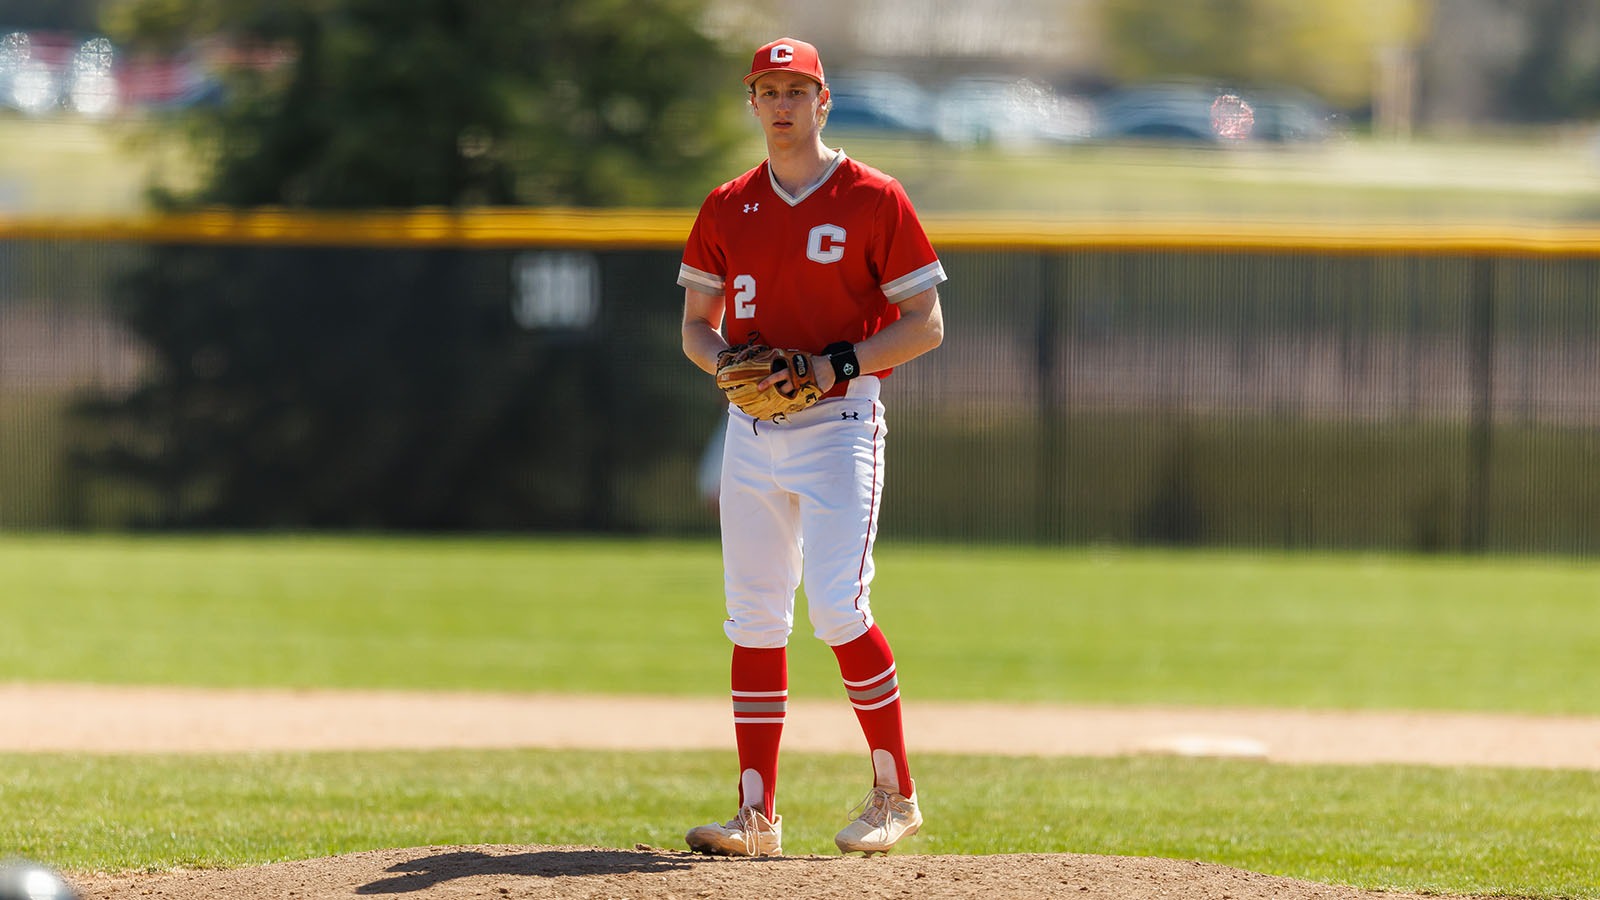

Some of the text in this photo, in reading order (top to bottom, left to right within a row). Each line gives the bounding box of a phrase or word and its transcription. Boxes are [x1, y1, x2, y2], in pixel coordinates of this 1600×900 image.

[770, 44, 794, 63] C
[806, 223, 847, 265] C
[733, 274, 757, 319] 2
